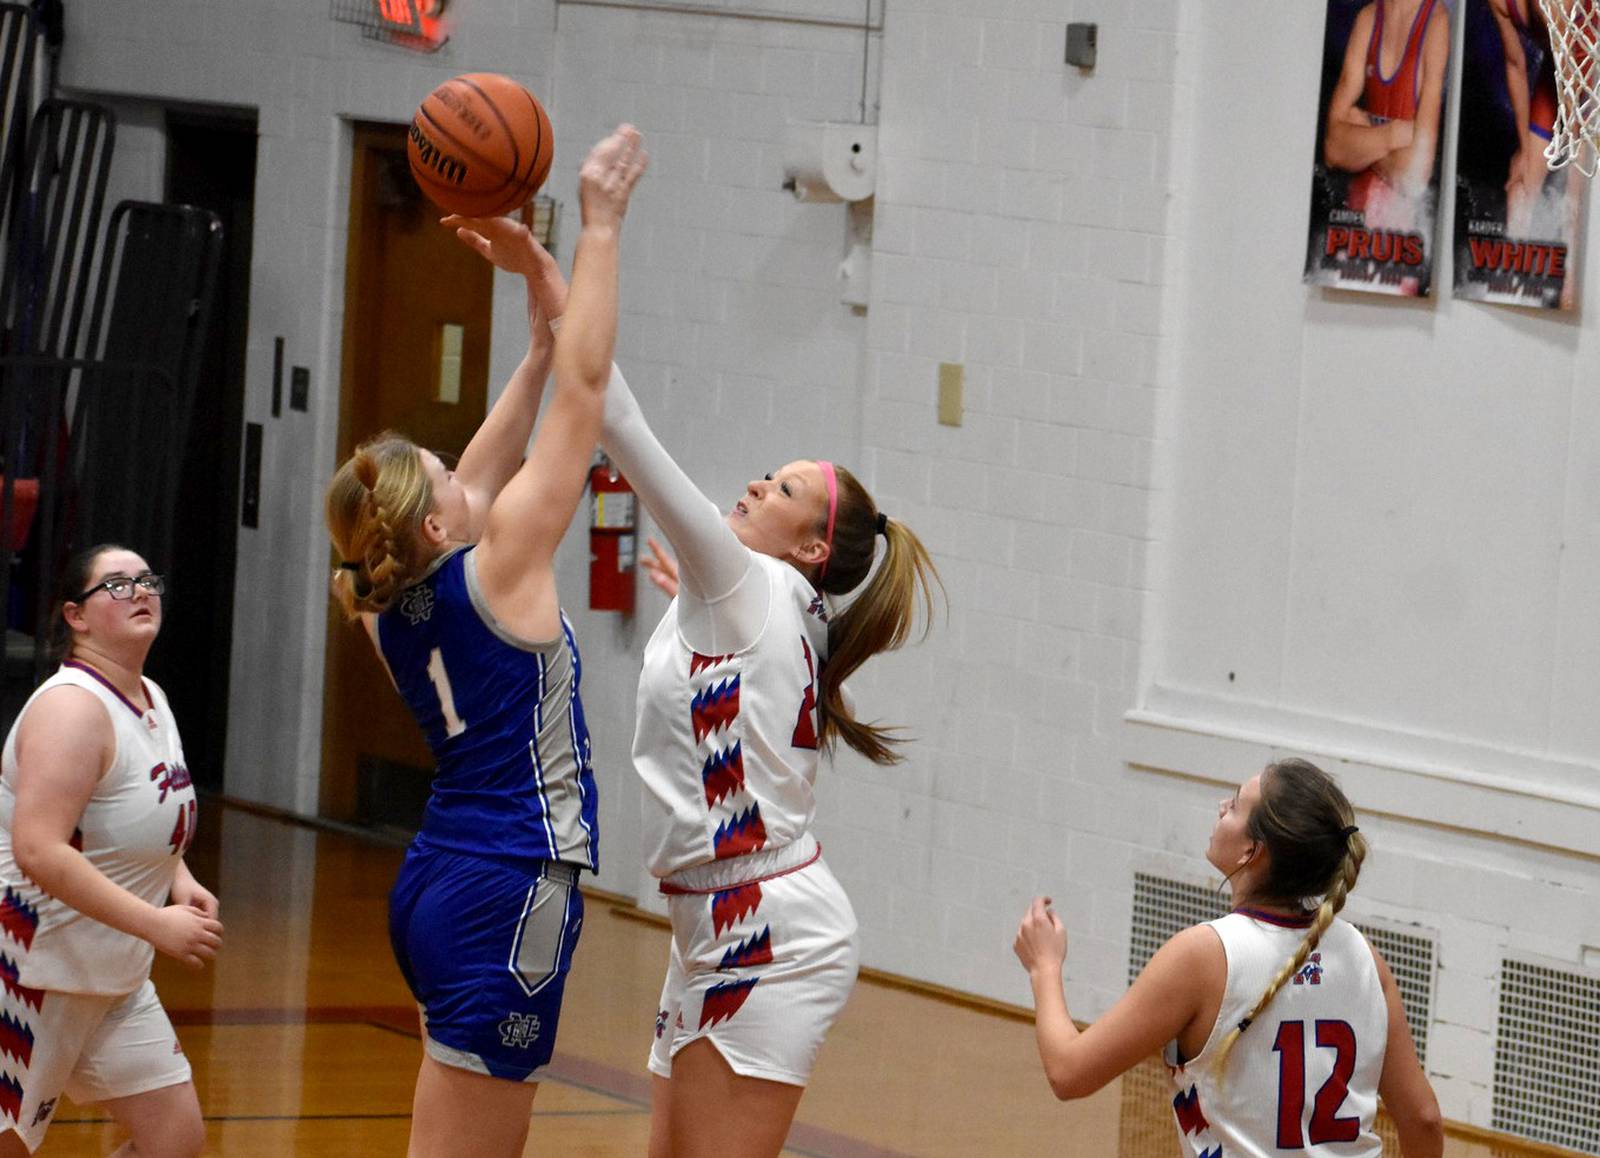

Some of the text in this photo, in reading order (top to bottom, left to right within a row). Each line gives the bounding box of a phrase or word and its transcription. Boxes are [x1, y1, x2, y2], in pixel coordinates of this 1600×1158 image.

[1325, 226, 1424, 266] PRUIS
[1469, 237, 1568, 279] WHITE
[426, 646, 468, 738] 1
[1271, 1018, 1360, 1150] 12
